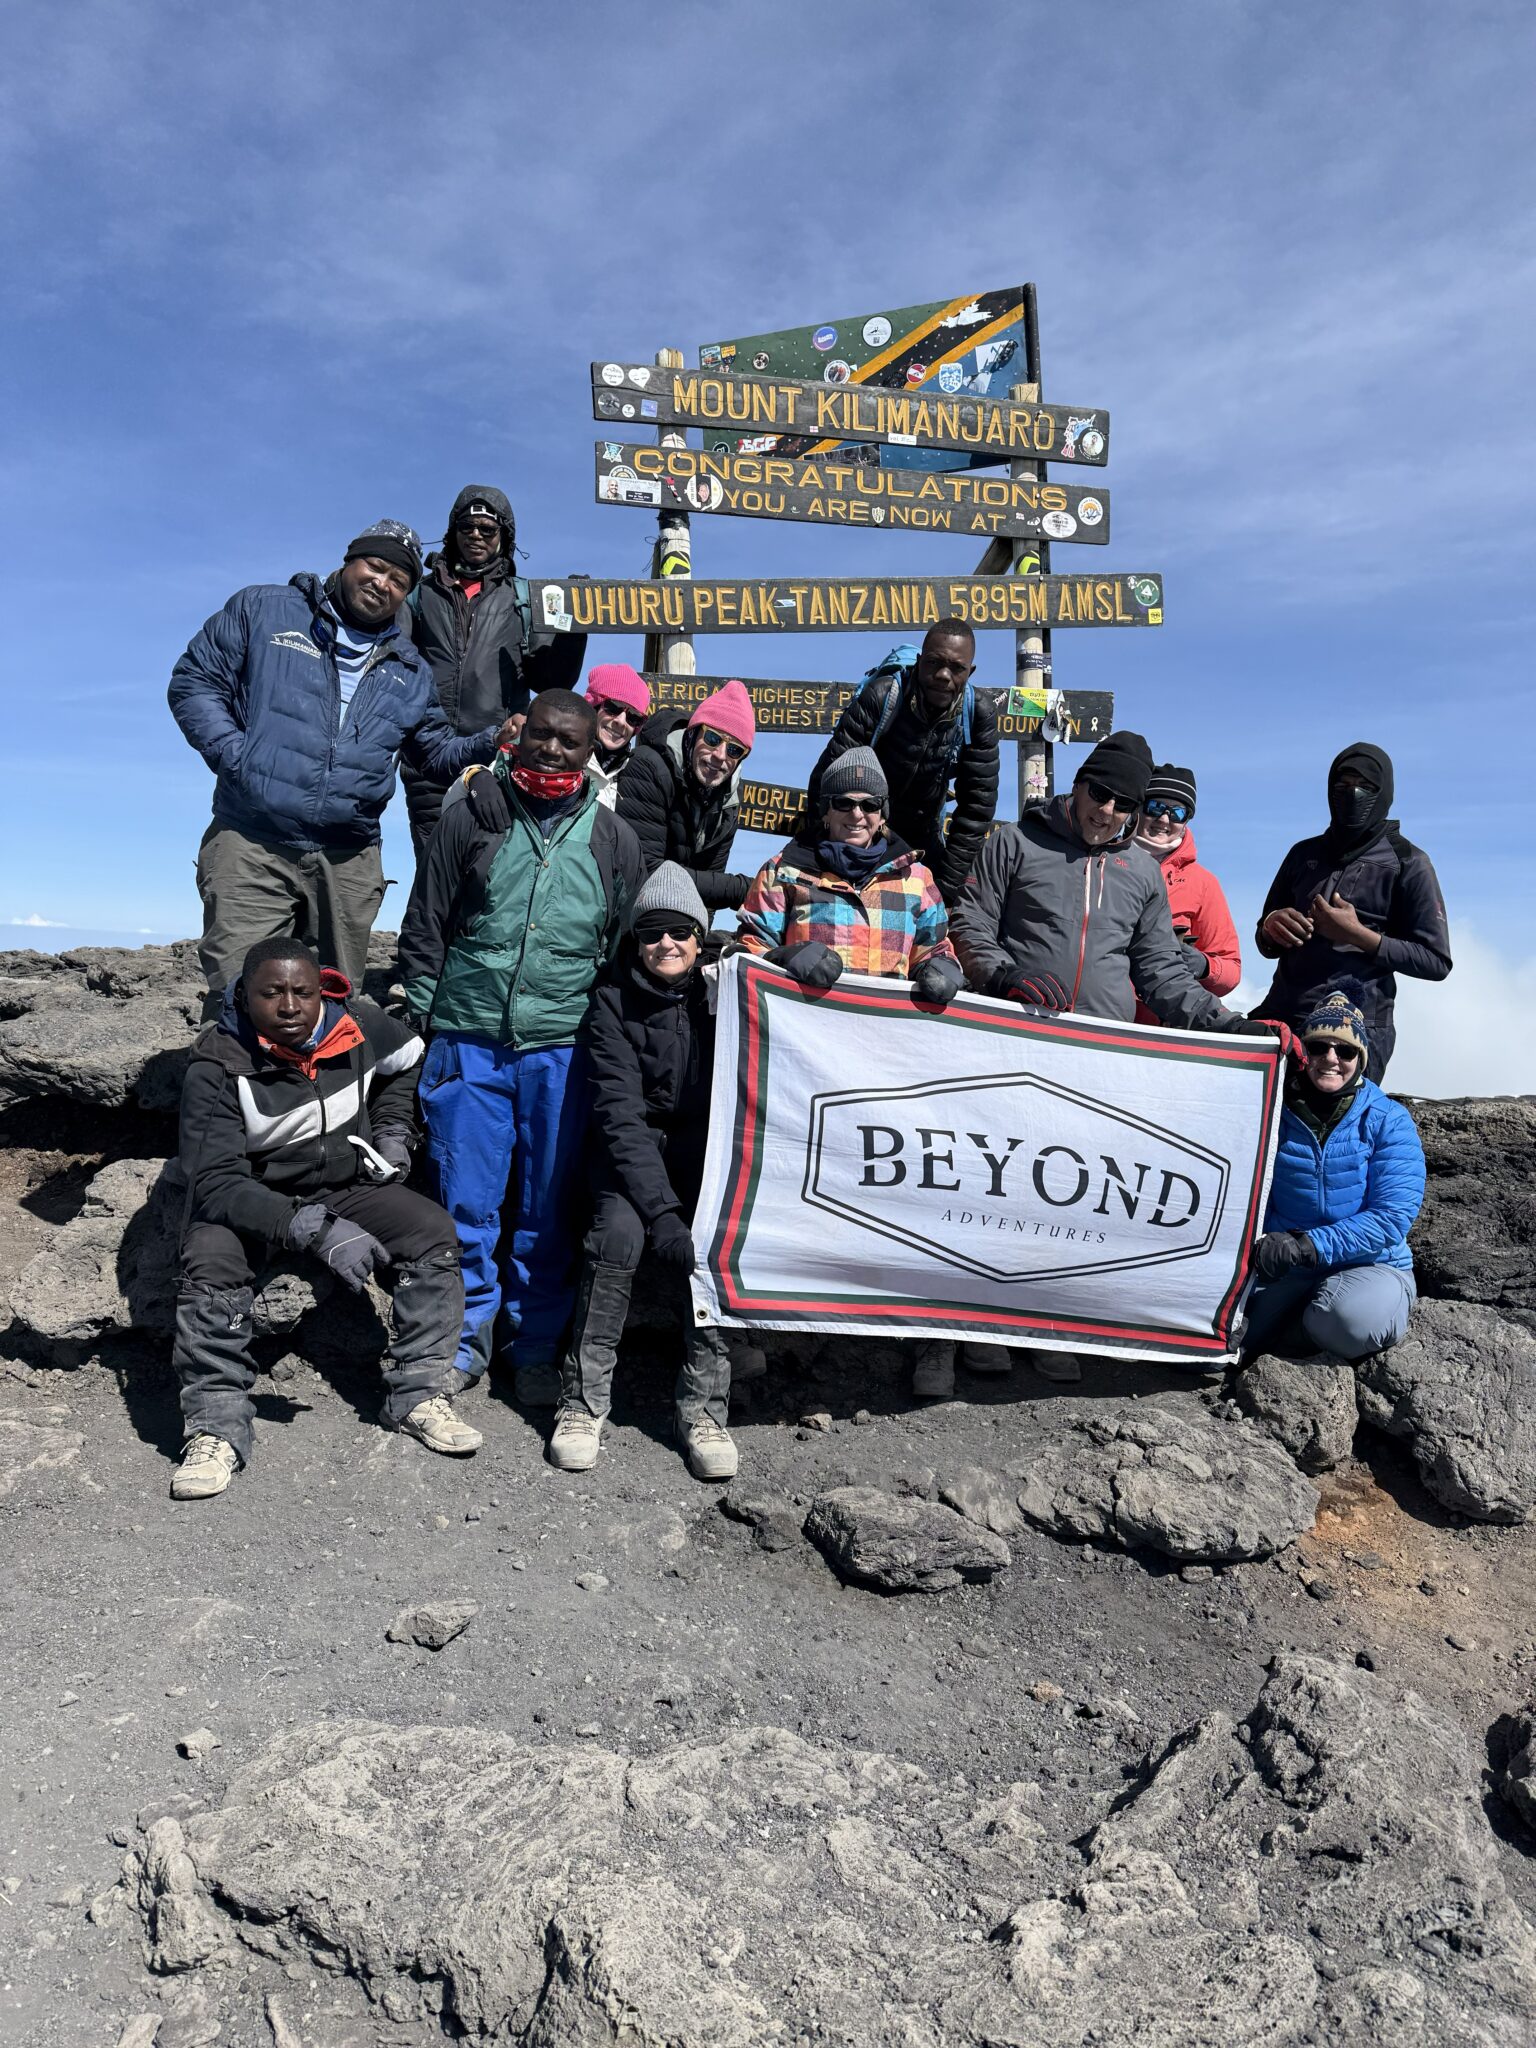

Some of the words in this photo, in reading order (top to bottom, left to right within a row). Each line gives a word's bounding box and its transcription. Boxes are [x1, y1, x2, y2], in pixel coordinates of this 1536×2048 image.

[673, 377, 802, 424] MOUNT
[817, 390, 1056, 450] KILIMANJARO
[634, 448, 1068, 511] CONGRATULATIONS
[724, 489, 785, 514] YOU
[807, 498, 870, 522] ARE
[890, 506, 951, 529] NOW
[971, 512, 1006, 532] AT
[571, 585, 684, 626] UHURU
[790, 584, 940, 625] TANZANIA
[950, 582, 1048, 623] 5895M
[1058, 581, 1133, 623] AMSL
[748, 687, 830, 706] HIGHEST
[857, 1125, 1201, 1228] BEYOND
[941, 1209, 1107, 1244] ADVENTURES
